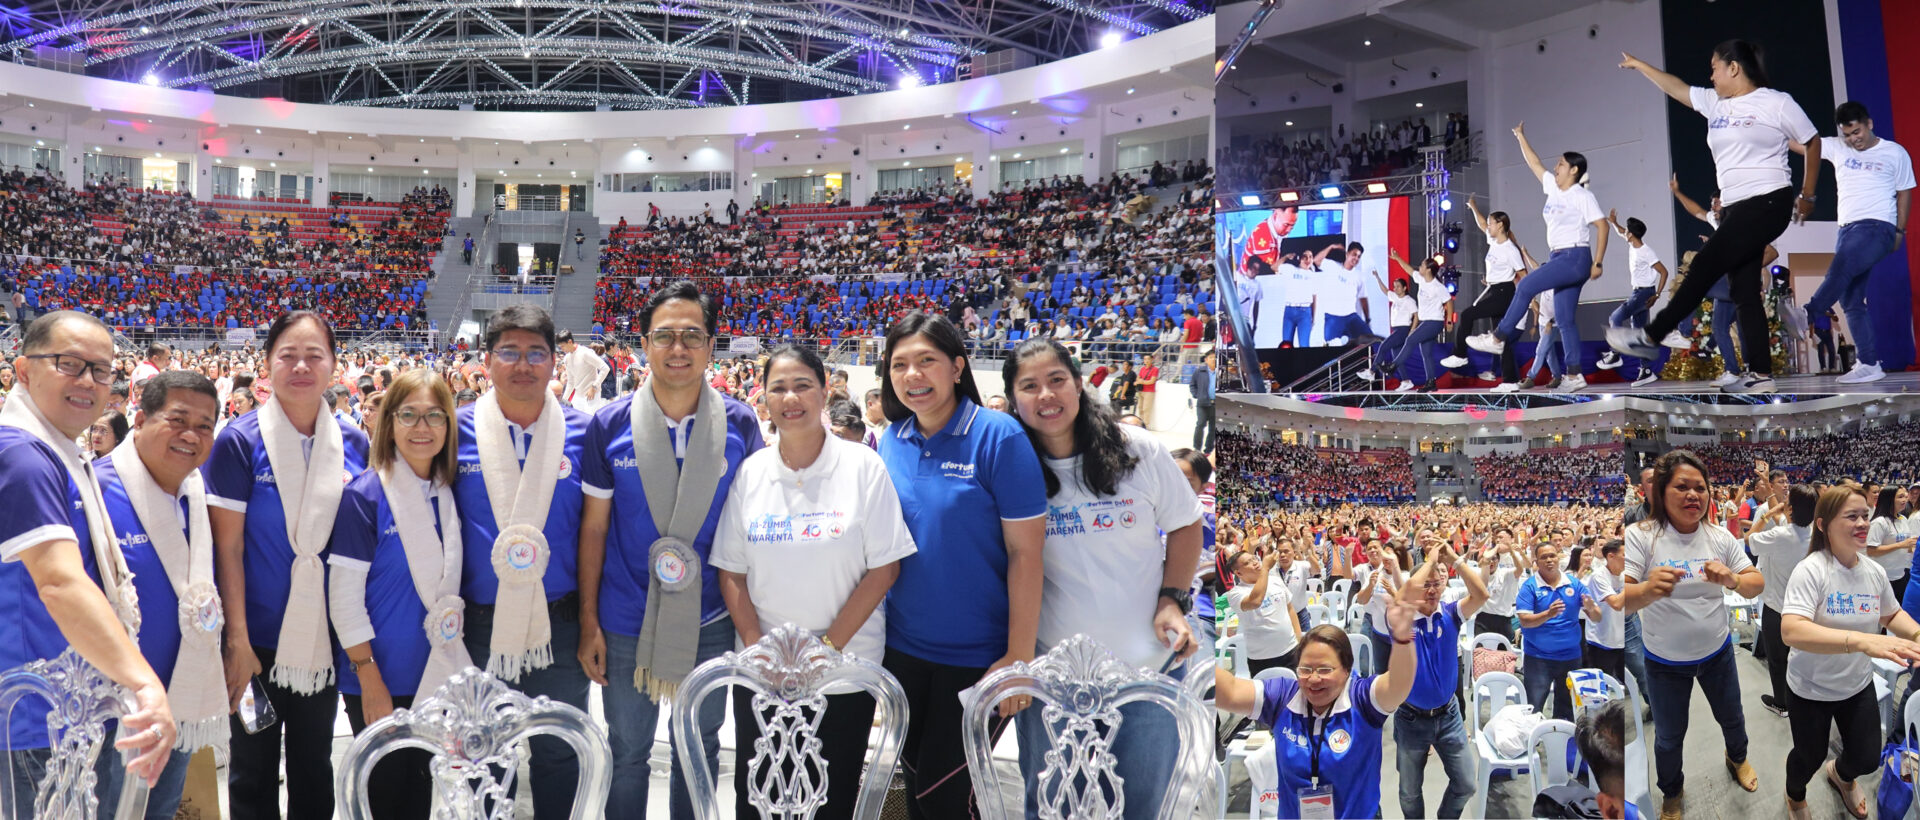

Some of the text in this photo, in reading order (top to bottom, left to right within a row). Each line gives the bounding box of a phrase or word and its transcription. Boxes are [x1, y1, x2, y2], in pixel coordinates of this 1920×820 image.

[1046, 511, 1081, 522] -ZUMBA
[1093, 514, 1113, 528] 40
[802, 524, 821, 537] 40
[747, 533, 794, 543] KWARENTA
[1826, 607, 1856, 615] KWARENTA
[1859, 602, 1870, 613] 40
